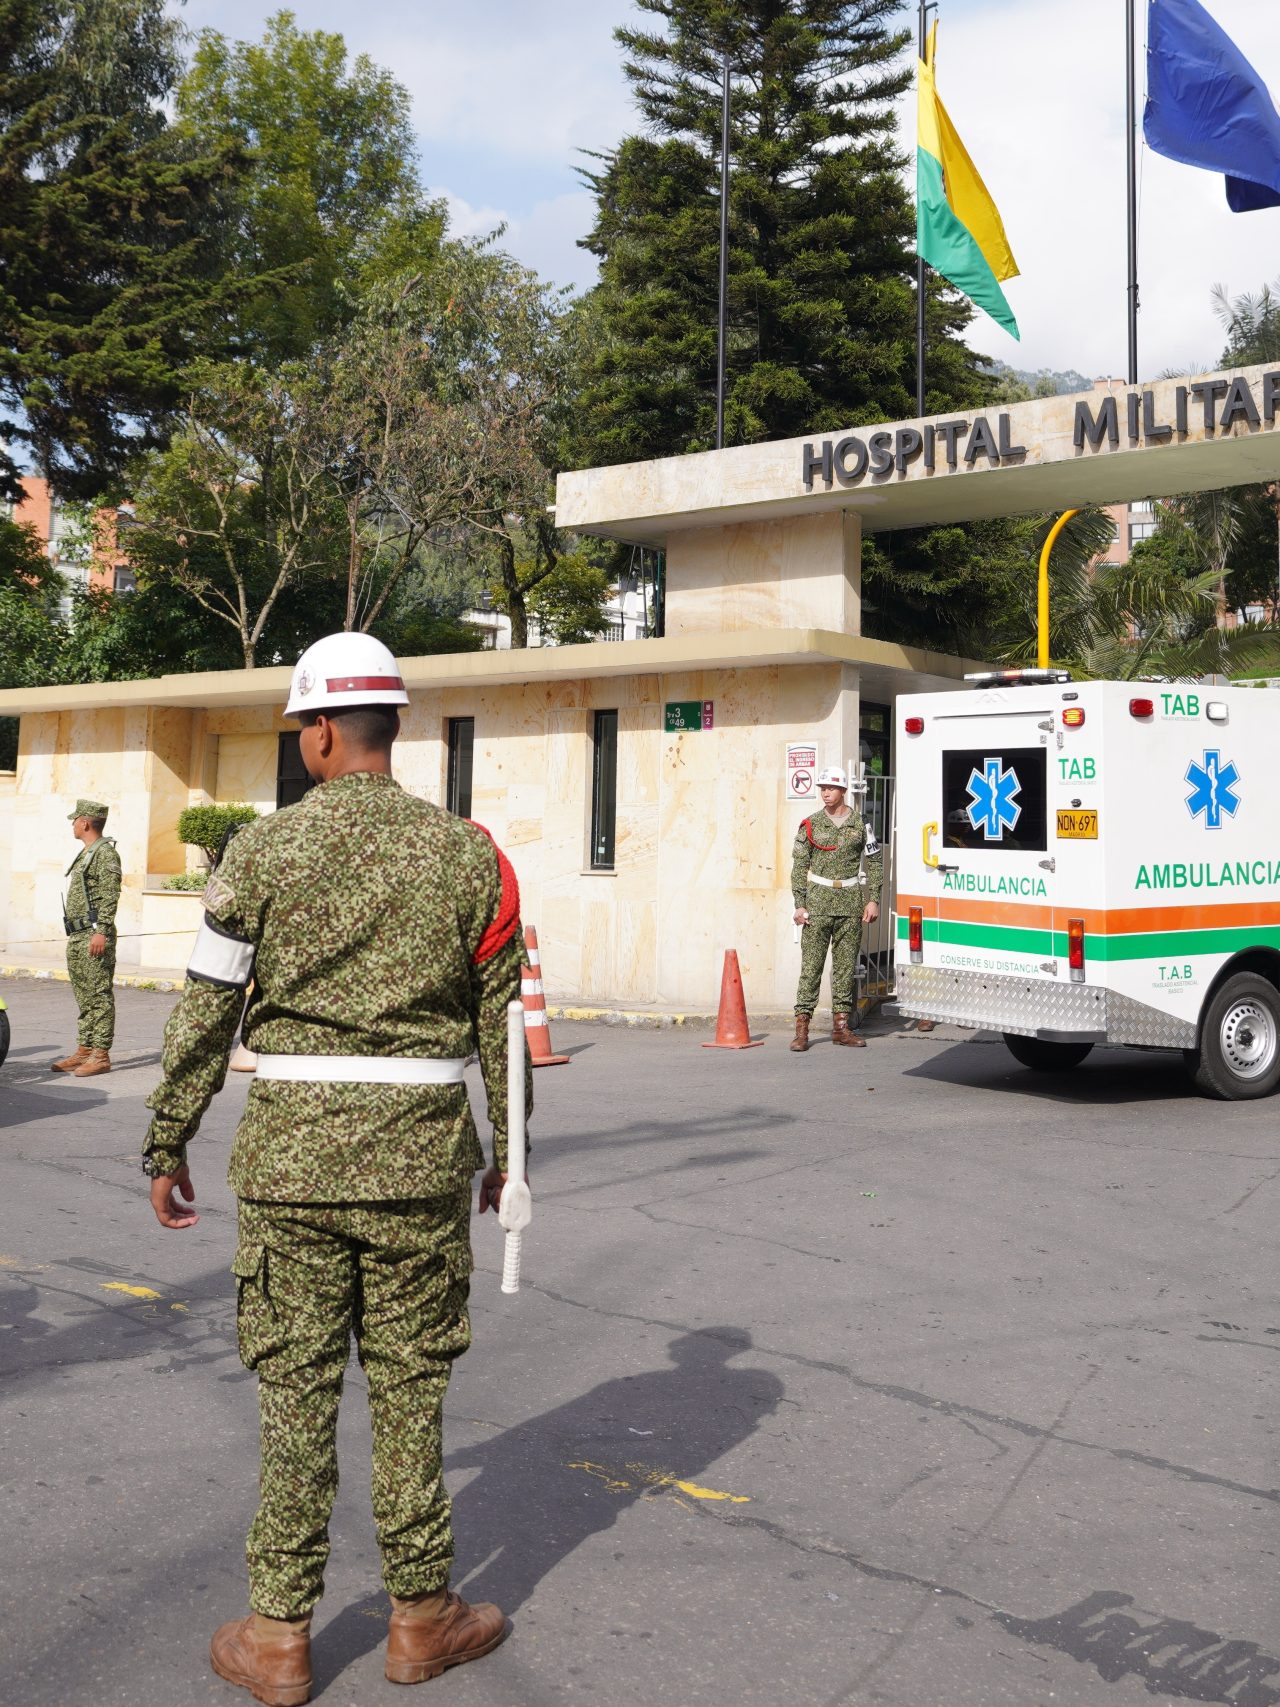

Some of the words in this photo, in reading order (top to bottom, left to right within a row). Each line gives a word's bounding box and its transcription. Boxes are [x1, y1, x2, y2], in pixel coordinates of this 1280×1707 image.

[803, 413, 1027, 486] HOSPITAL
[675, 707, 681, 718] 3
[1160, 694, 1199, 716] TAB
[675, 719, 685, 727] 49
[1058, 758, 1096, 780] TAB
[943, 873, 1047, 897] AMBULANCIA
[940, 954, 981, 968] CONSERVE
[983, 959, 994, 970] SU
[996, 960, 1039, 974] DISTANCIA
